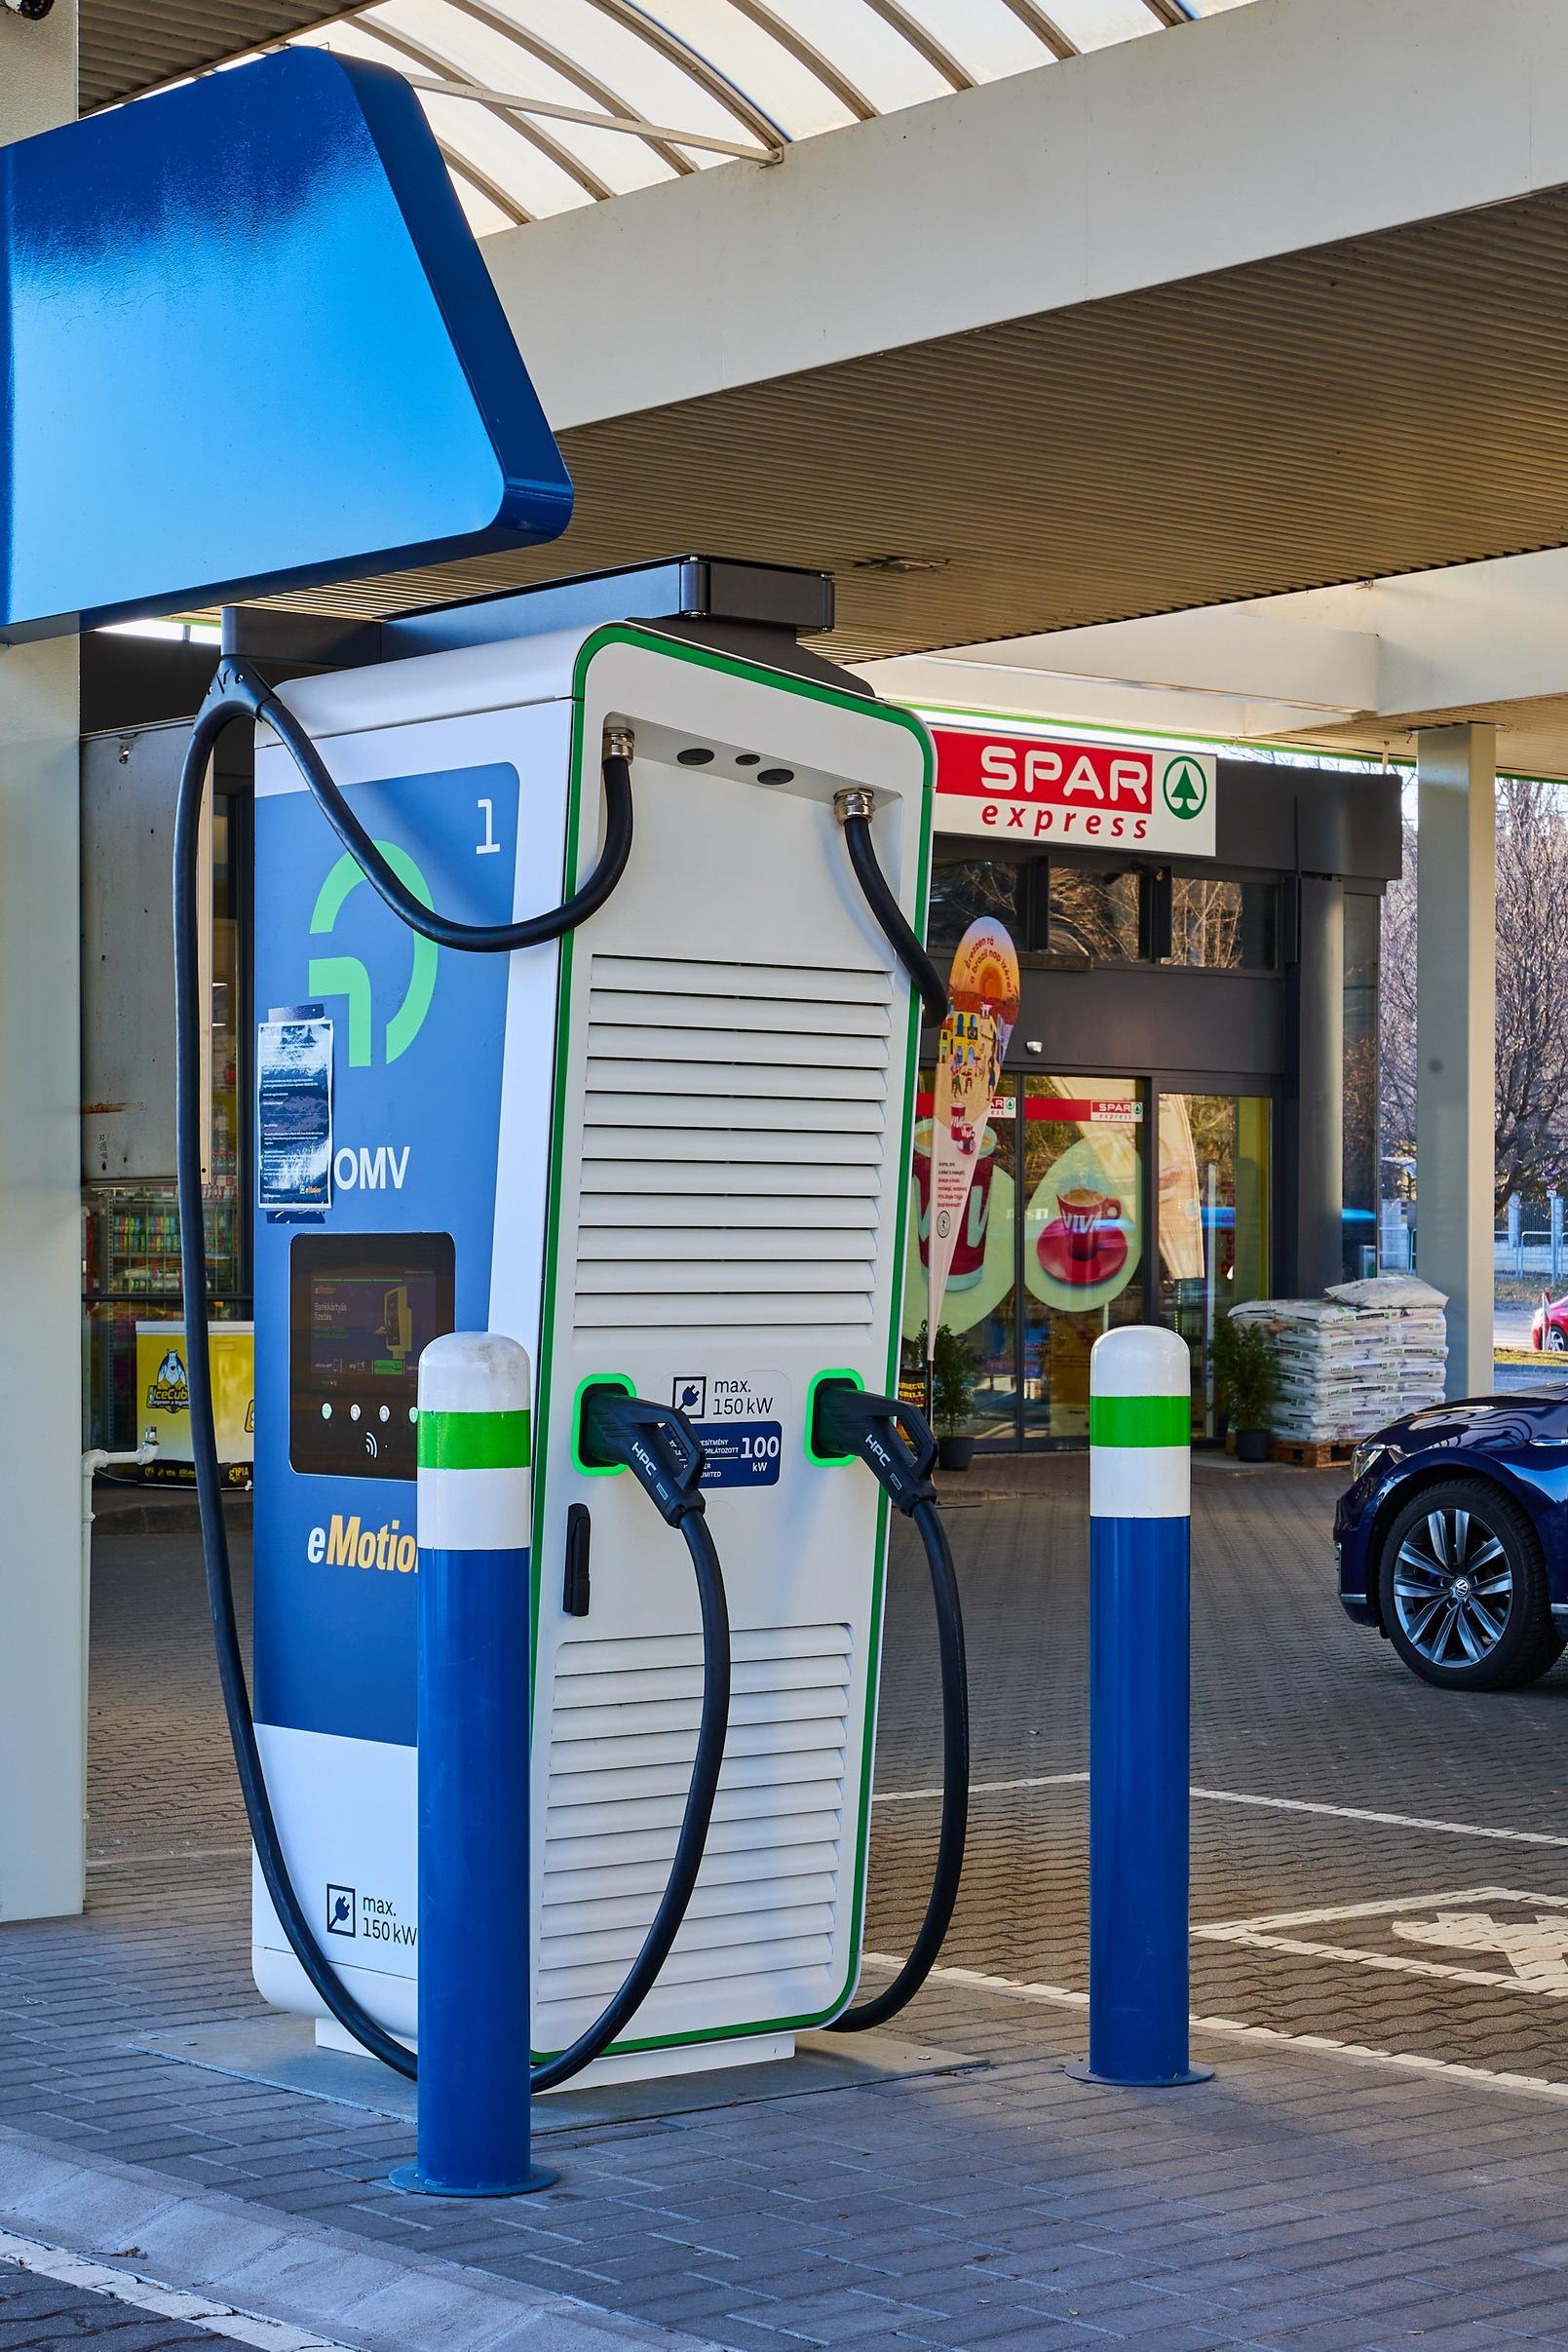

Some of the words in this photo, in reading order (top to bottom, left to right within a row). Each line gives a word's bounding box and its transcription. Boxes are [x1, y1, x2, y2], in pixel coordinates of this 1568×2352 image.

[980, 746, 1148, 804] SPAR
[476, 797, 501, 855] 1
[981, 803, 1147, 839] express
[1098, 1102, 1131, 1112] SPAR
[334, 1146, 411, 1190] OMV
[713, 1378, 752, 1394] max.
[712, 1398, 744, 1415] 150
[746, 1397, 774, 1414] kW
[700, 1438, 729, 1446] ESÍTMÉNY
[740, 1436, 780, 1459] 100
[864, 1433, 891, 1467] HPC
[631, 1442, 658, 1477] HPC
[751, 1461, 768, 1472] kW
[307, 1514, 419, 1574] eMotio
[363, 1896, 397, 1917] max.
[363, 1917, 391, 1942] 150
[393, 1922, 418, 1947] kW
